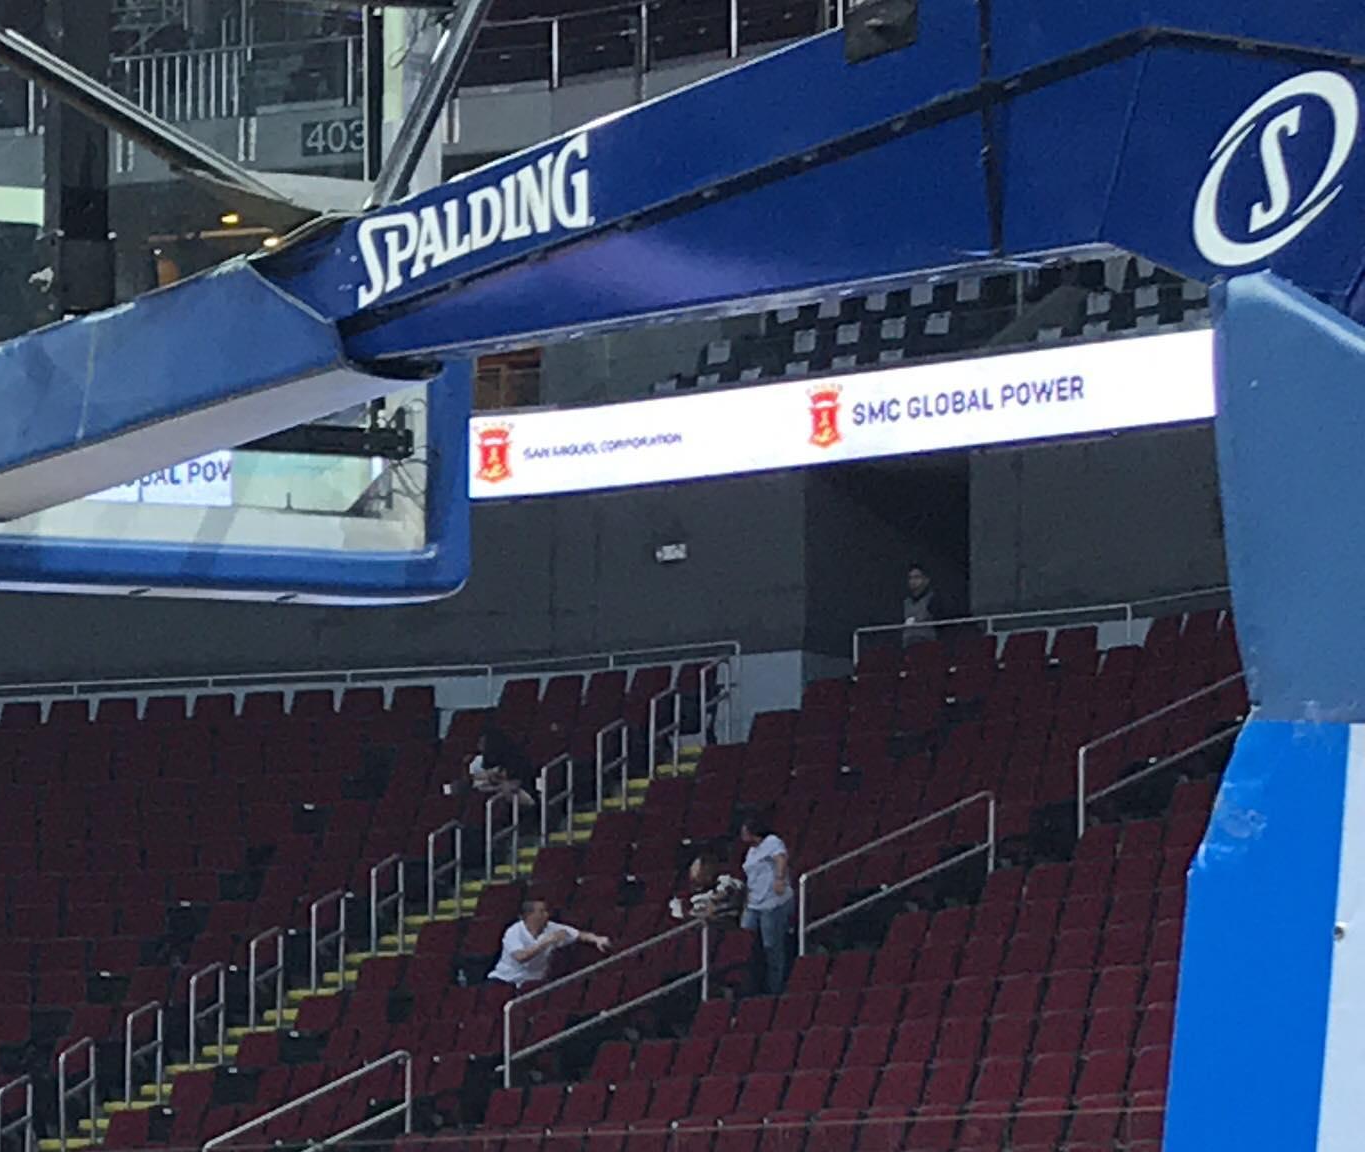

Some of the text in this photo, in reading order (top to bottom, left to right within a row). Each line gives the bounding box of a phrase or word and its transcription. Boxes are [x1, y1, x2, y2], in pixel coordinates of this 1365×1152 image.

[358, 132, 590, 309] SPALDING
[852, 375, 1084, 426] SMC GLOBAL POWER
